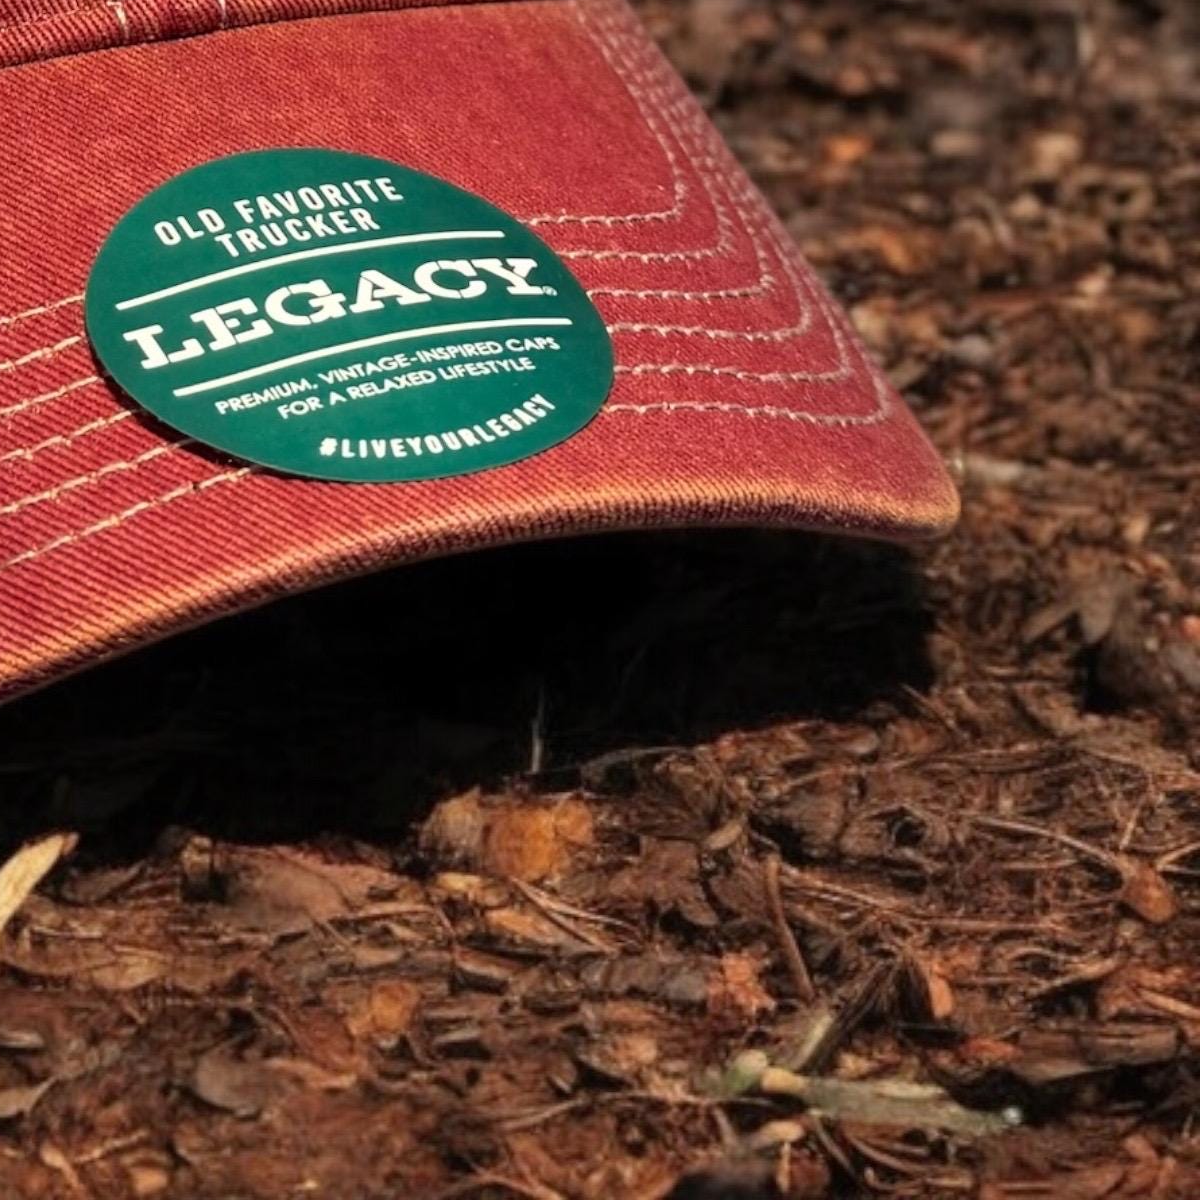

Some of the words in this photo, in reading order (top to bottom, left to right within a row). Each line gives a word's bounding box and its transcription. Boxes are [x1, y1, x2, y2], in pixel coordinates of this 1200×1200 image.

[154, 208, 226, 246] OLD
[233, 177, 404, 224] FAVORITE
[213, 207, 381, 258] TRUCKER
[276, 396, 324, 420] FOR
[328, 390, 348, 406] A
[346, 370, 438, 400] RELAXED
[439, 356, 536, 381] LIFESTYLE
[317, 340, 504, 385] VINTAGE-INSPIRED
[506, 336, 561, 353] CAPS
[318, 393, 556, 459] #LIVEYOURLEGACY
